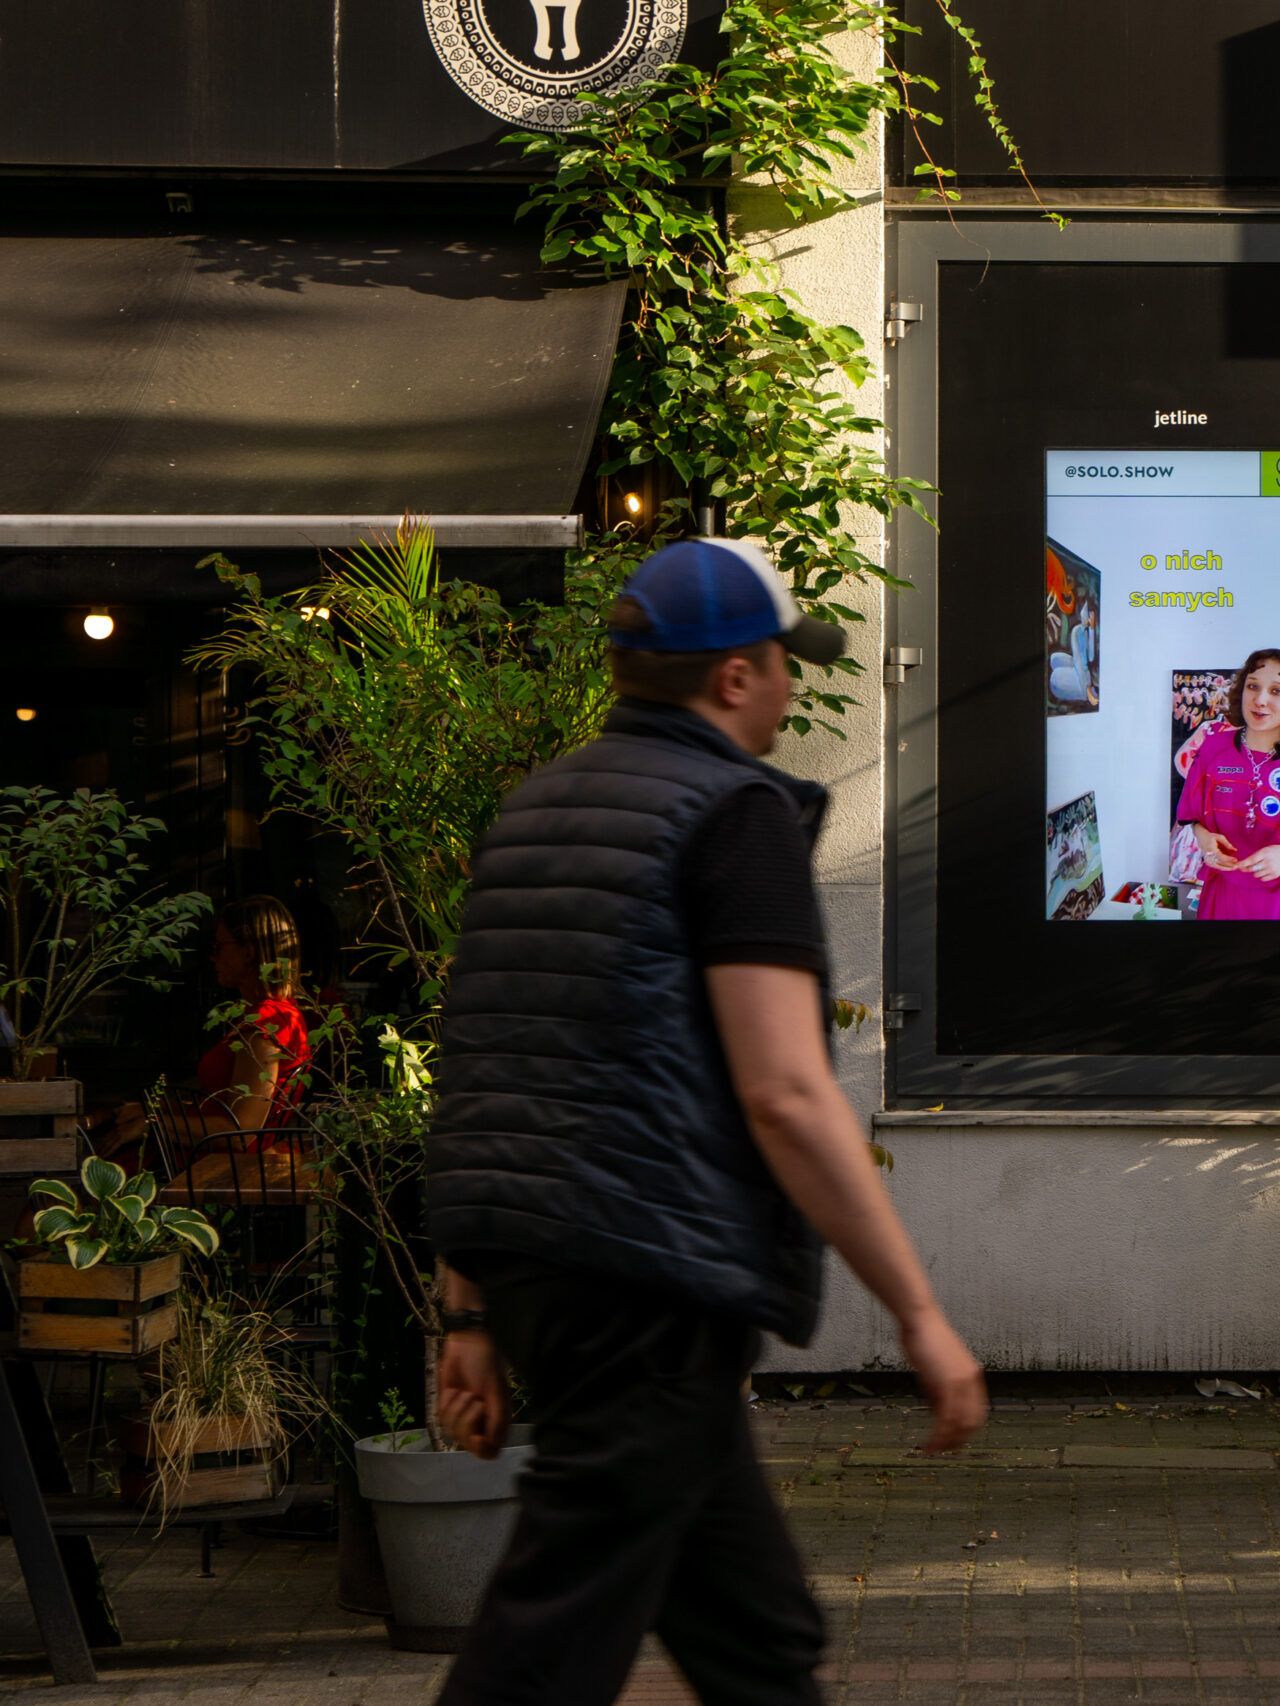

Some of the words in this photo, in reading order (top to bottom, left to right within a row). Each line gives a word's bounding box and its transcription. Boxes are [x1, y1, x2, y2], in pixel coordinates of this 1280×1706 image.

[1153, 410, 1208, 428] jetline
[1065, 465, 1174, 478] @SOLO.SHOW
[1140, 554, 1157, 570] o
[1165, 550, 1222, 570] nich
[1128, 587, 1234, 612] samych
